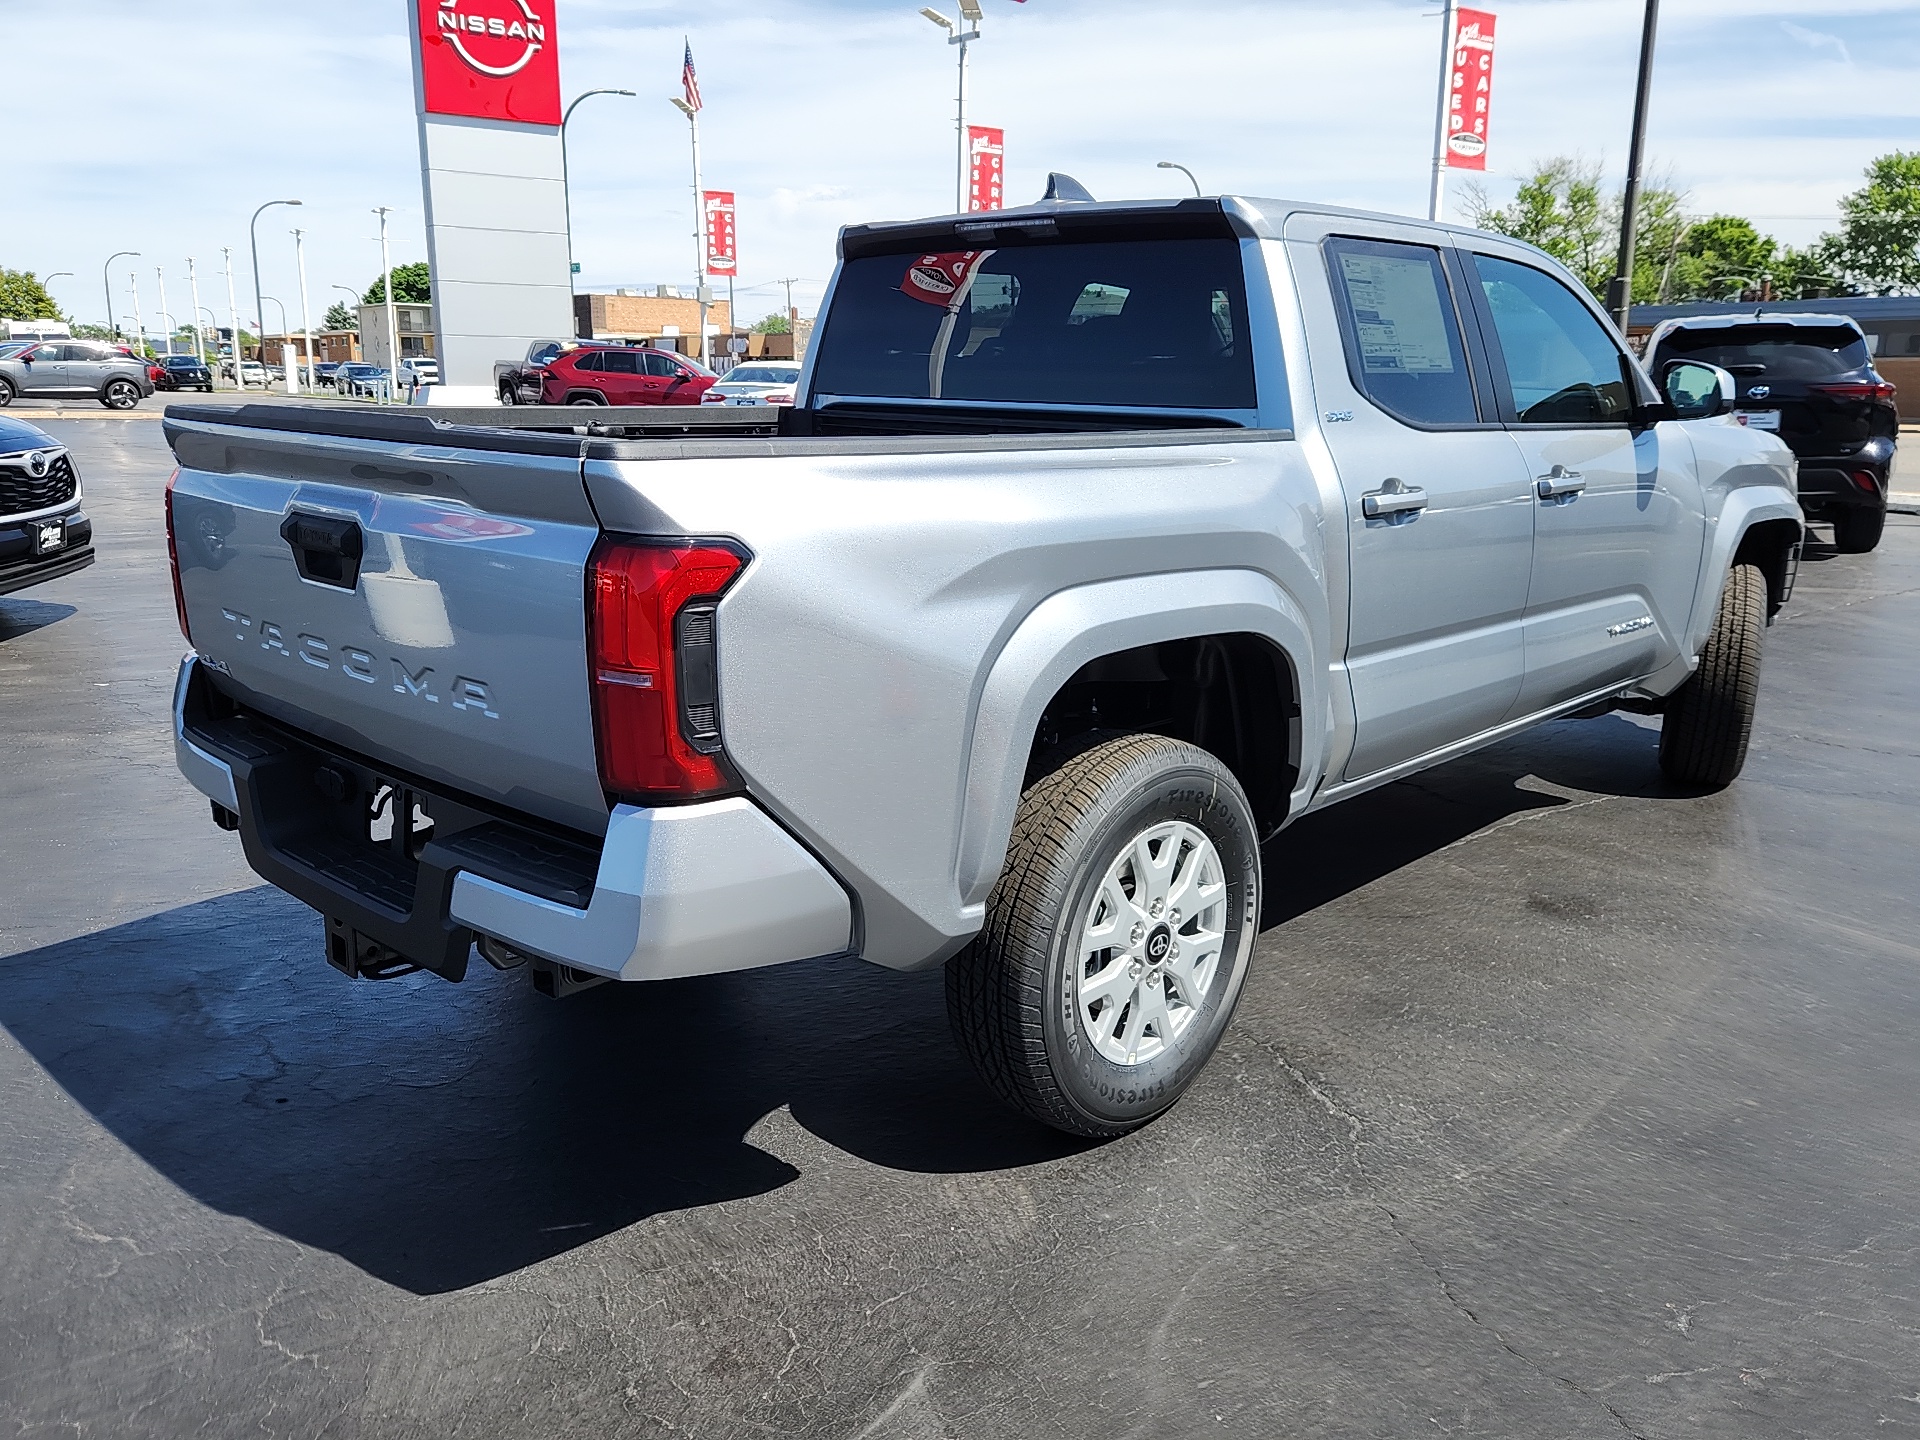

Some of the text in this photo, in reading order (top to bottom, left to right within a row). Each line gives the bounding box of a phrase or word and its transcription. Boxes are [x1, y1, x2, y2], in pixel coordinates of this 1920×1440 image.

[438, 10, 545, 42] NISSAN
[1451, 51, 1468, 130] USED
[1473, 54, 1490, 134] CARS
[971, 154, 981, 210] USED
[990, 158, 1000, 211] CARS
[707, 212, 717, 256] USED
[724, 213, 733, 257] CARS
[222, 607, 500, 719] TACOMA
[1166, 788, 1243, 838] Firestone
